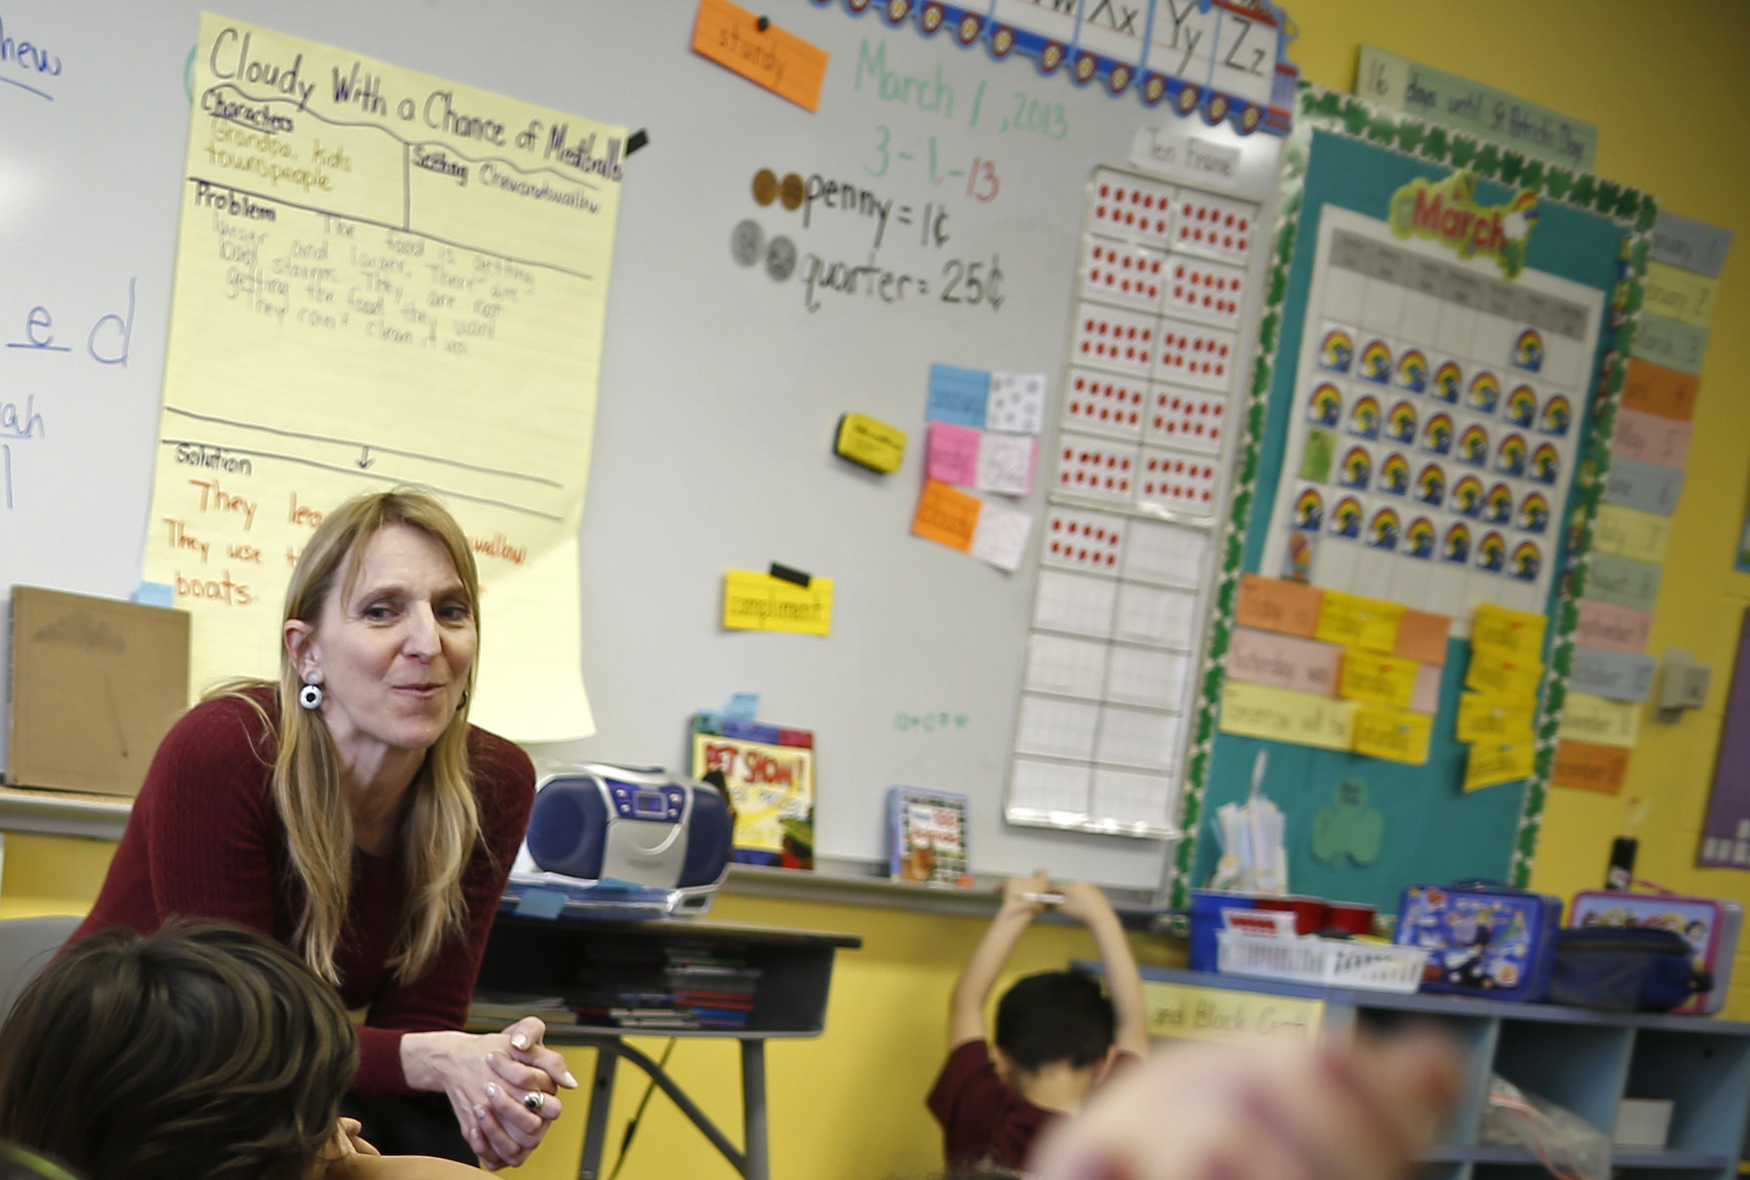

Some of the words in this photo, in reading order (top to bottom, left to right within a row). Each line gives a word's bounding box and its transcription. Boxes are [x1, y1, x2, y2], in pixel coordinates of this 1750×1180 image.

[209, 26, 316, 111] Cloudy
[331, 59, 387, 118] With
[397, 98, 416, 121] a
[423, 88, 506, 147] Chance
[515, 119, 543, 152] of
[854, 36, 955, 118] March
[195, 180, 277, 221] Problem
[1412, 187, 1506, 252] March
[175, 443, 253, 476] Solution
[189, 479, 258, 531] They
[162, 518, 210, 563] They
[227, 545, 263, 565] use
